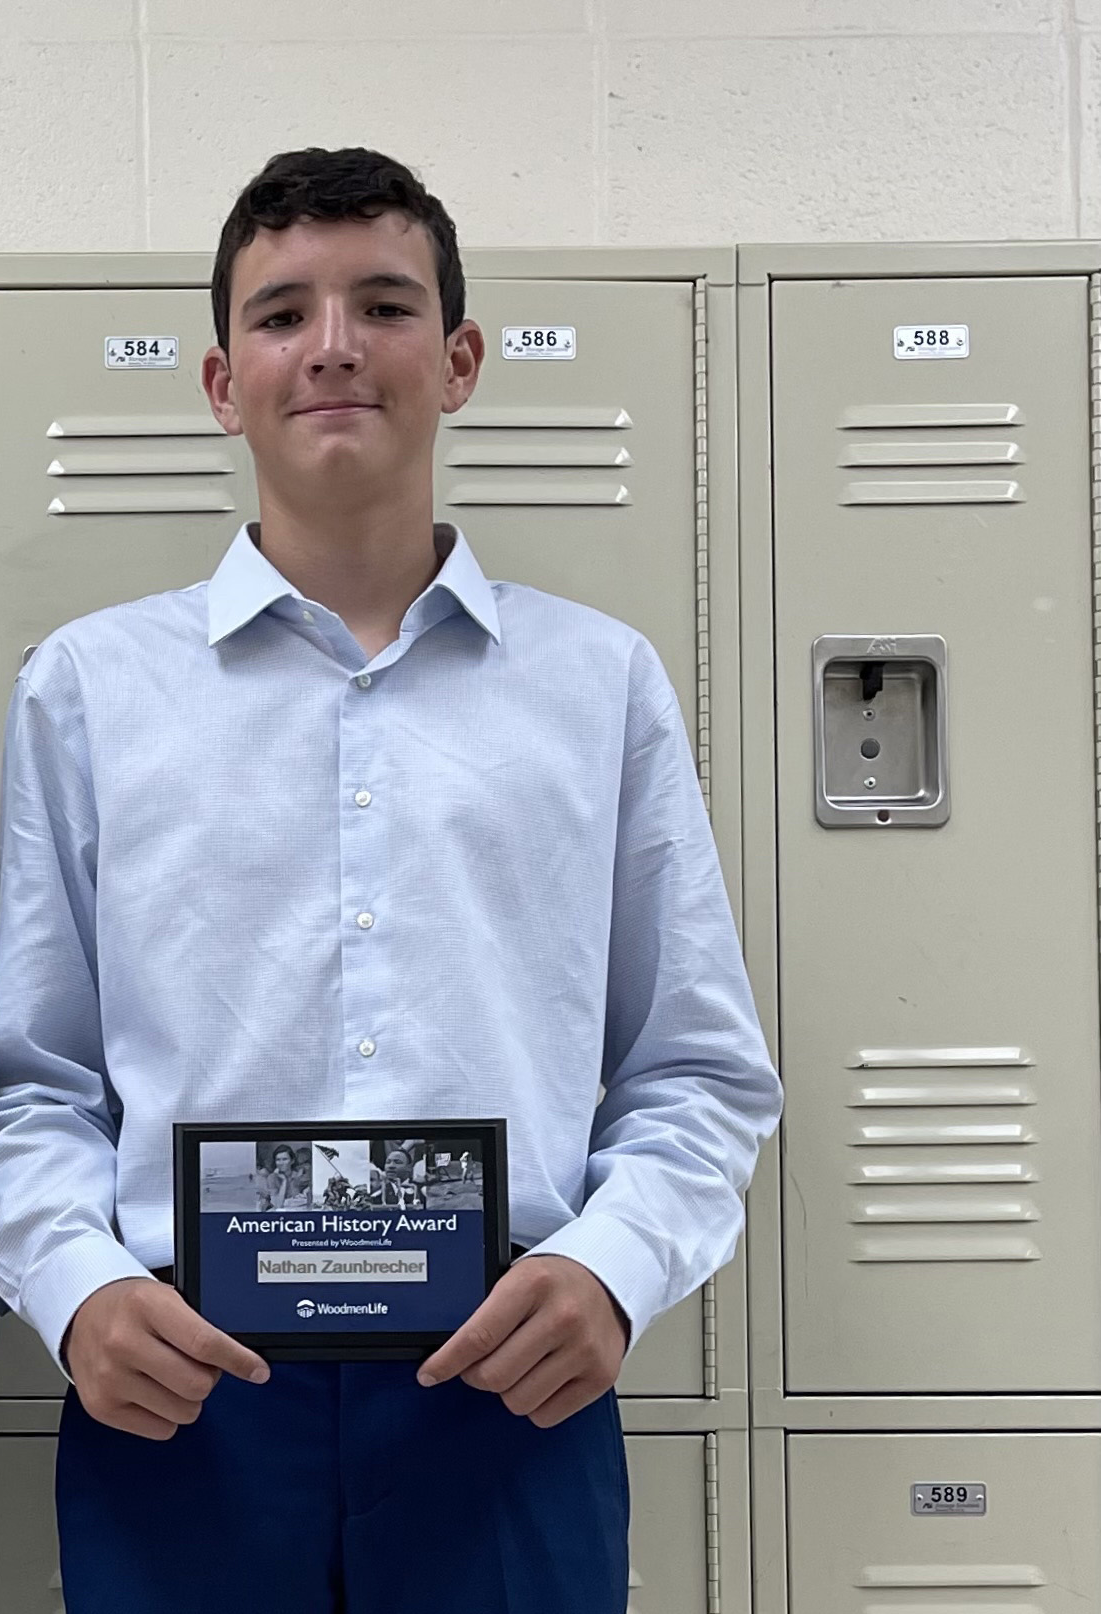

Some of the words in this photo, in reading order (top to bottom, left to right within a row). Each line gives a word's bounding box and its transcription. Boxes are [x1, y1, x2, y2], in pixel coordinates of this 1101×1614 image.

[521, 331, 557, 346] 586
[913, 330, 949, 345] 588
[124, 340, 160, 356] 584
[226, 1215, 315, 1233] American
[322, 1214, 392, 1236] History
[395, 1214, 457, 1231] Award
[291, 1239, 329, 1247] Presented
[330, 1239, 339, 1248] by
[259, 1260, 317, 1274] Nathan
[320, 1259, 425, 1274] Zaunbrecher
[317, 1302, 388, 1314] WoodmenLife
[931, 1487, 967, 1503] 589
